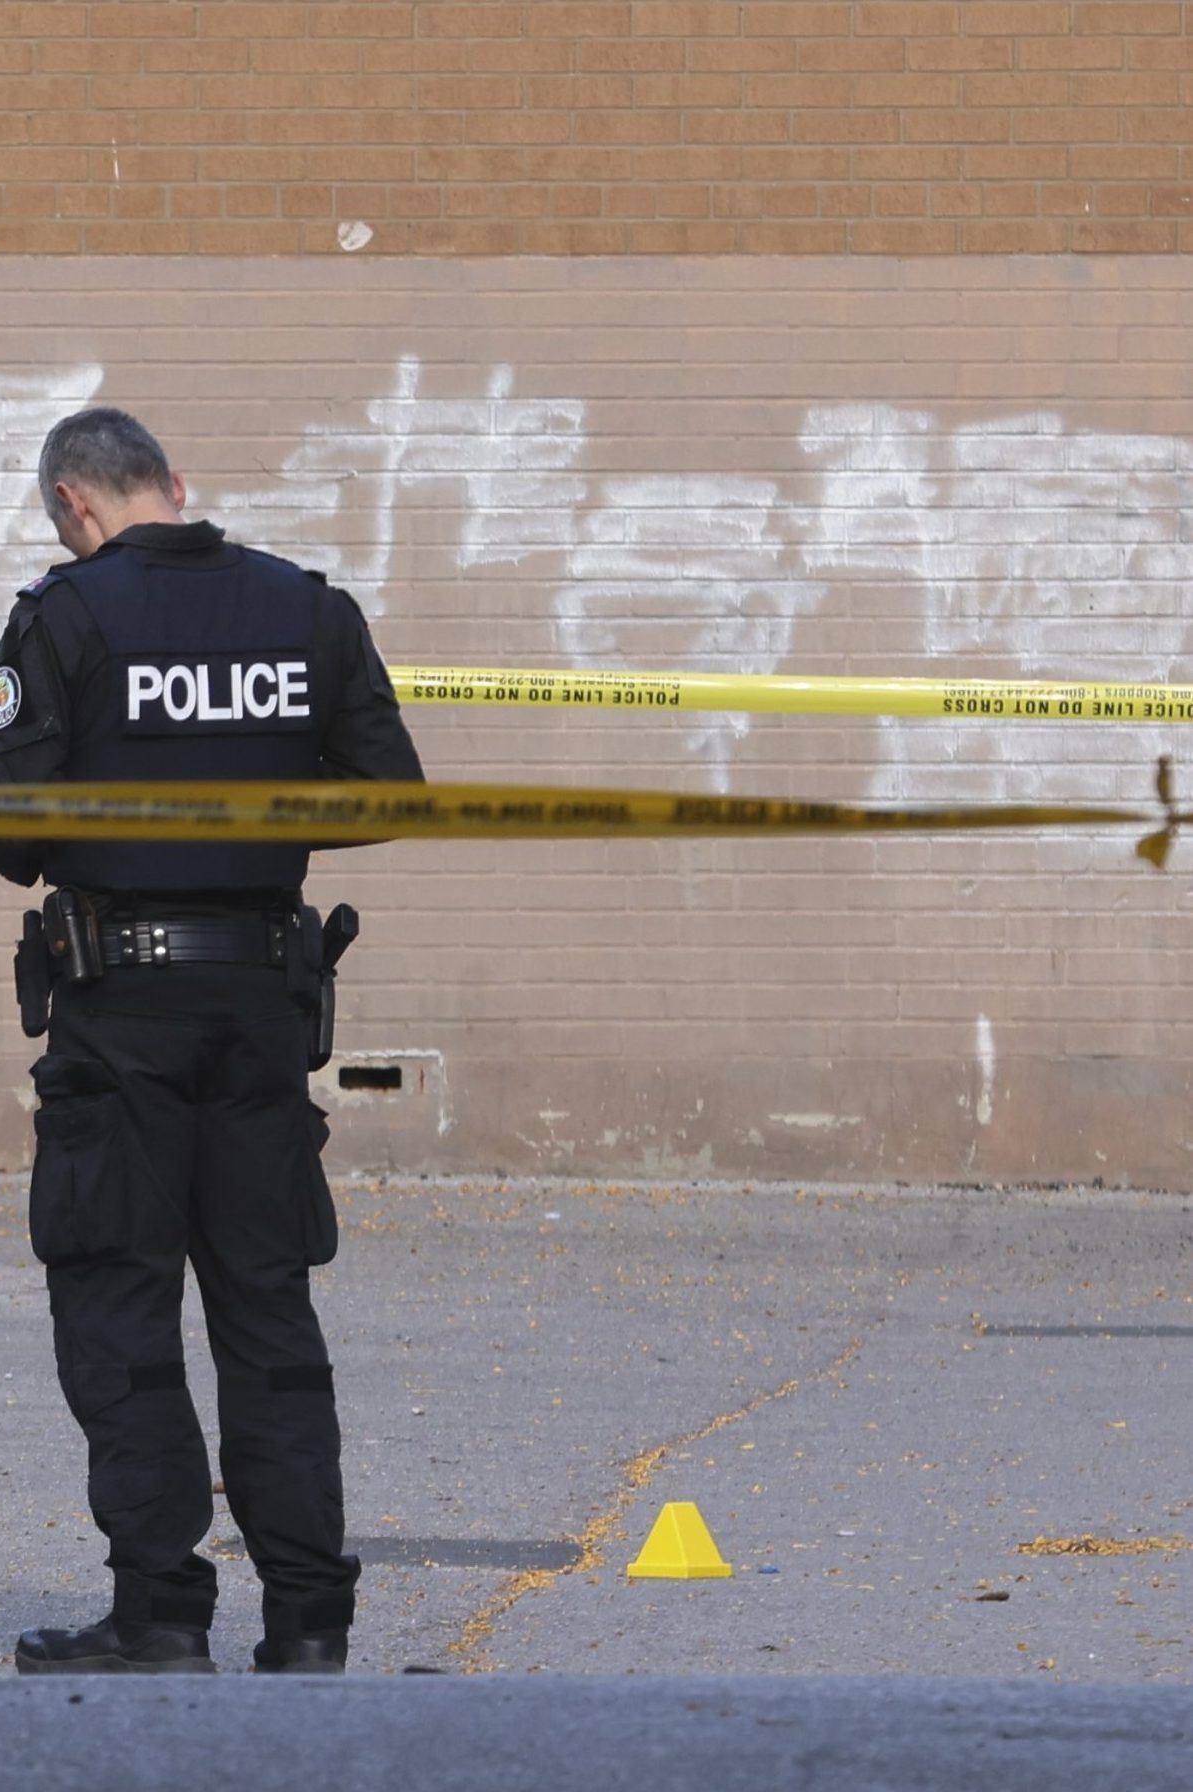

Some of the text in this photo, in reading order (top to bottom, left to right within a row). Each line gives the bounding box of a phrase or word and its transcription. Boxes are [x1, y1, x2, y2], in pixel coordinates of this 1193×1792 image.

[128, 662, 310, 721] POLICE
[413, 685, 680, 705] POLICE LINE DO NOT CROSS
[943, 698, 1193, 718] OLICE LINE DO NOT CROSS
